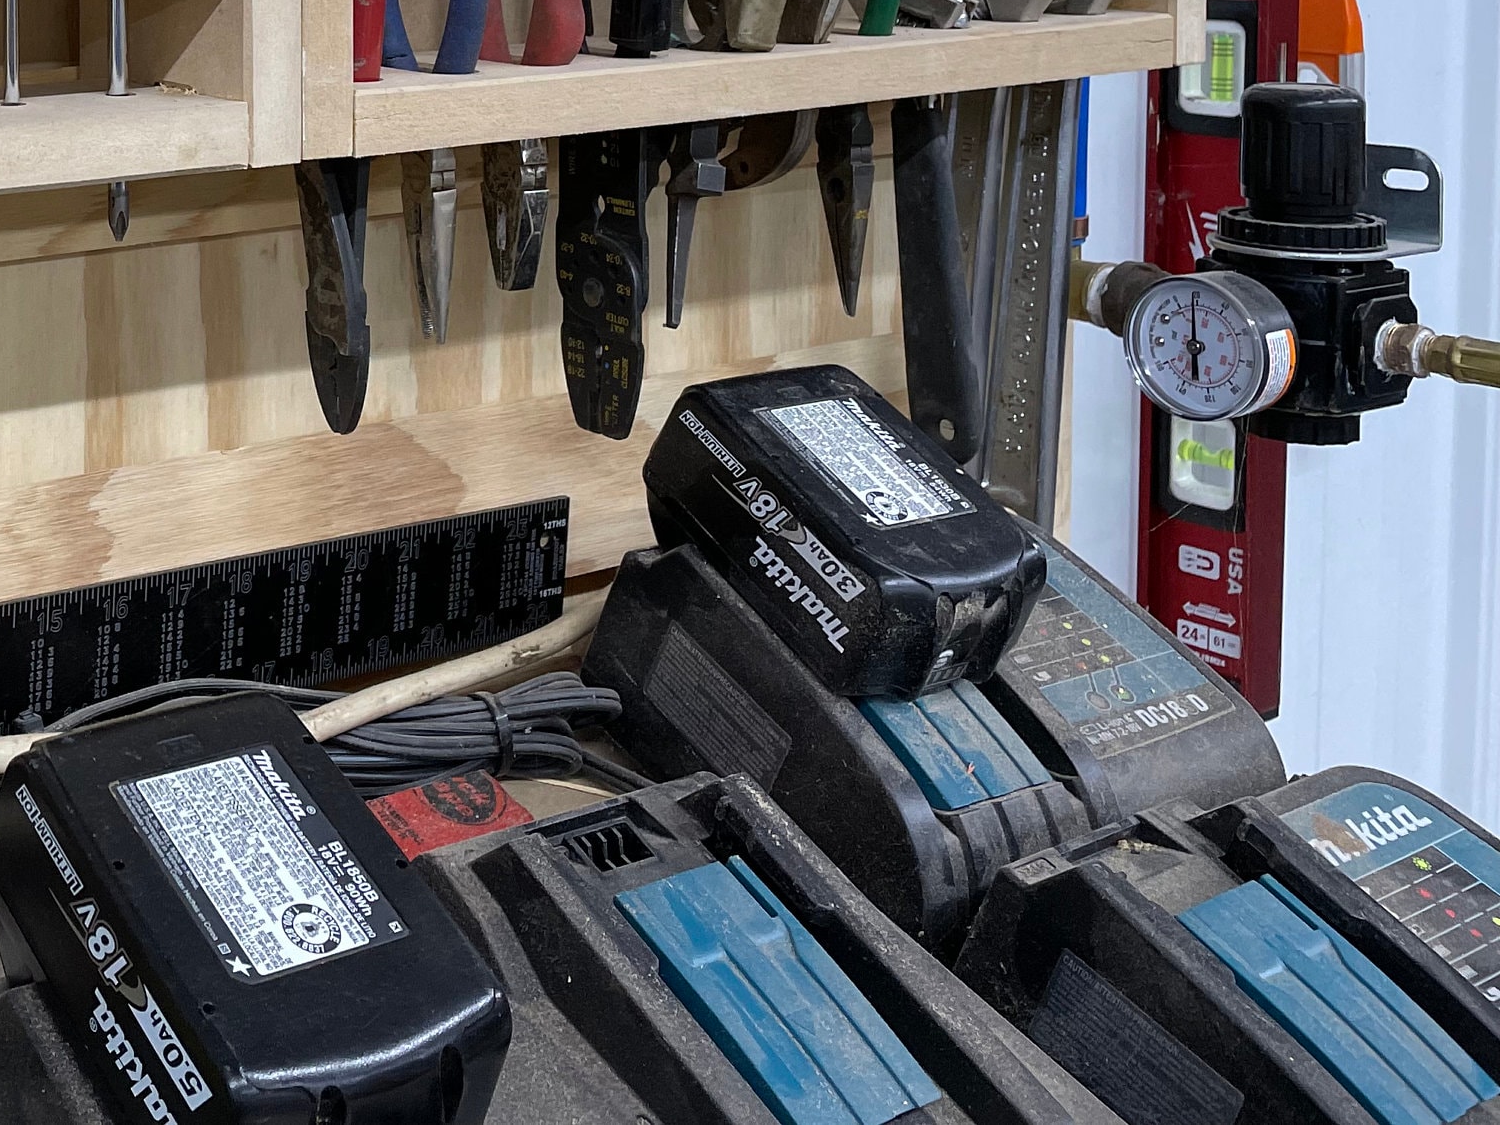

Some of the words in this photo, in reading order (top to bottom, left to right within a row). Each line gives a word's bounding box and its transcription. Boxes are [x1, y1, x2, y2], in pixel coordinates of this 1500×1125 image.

[605, 311, 628, 326] CUTTER
[679, 410, 746, 477] LITHIUM-ION
[739, 480, 788, 531] 18V
[344, 548, 369, 573] 20
[399, 539, 421, 562] 21
[810, 540, 858, 593] 3.0Ah
[229, 571, 253, 596] 18
[288, 559, 311, 583] 19
[1228, 547, 1243, 594] USA
[103, 596, 129, 621] 16
[167, 583, 192, 608] 17
[37, 608, 64, 635] 15
[1181, 625, 1199, 642] 24
[311, 648, 334, 672] 18
[16, 784, 84, 896] LITHIUM-ION
[1308, 804, 1433, 867] mkita
[327, 840, 379, 903] BL1850B
[344, 882, 372, 917] 90Wh
[311, 906, 341, 944] RECYCLE
[76, 903, 129, 987] 18V
[93, 987, 180, 1125] akita
[149, 1008, 204, 1098] 5.0Ah
